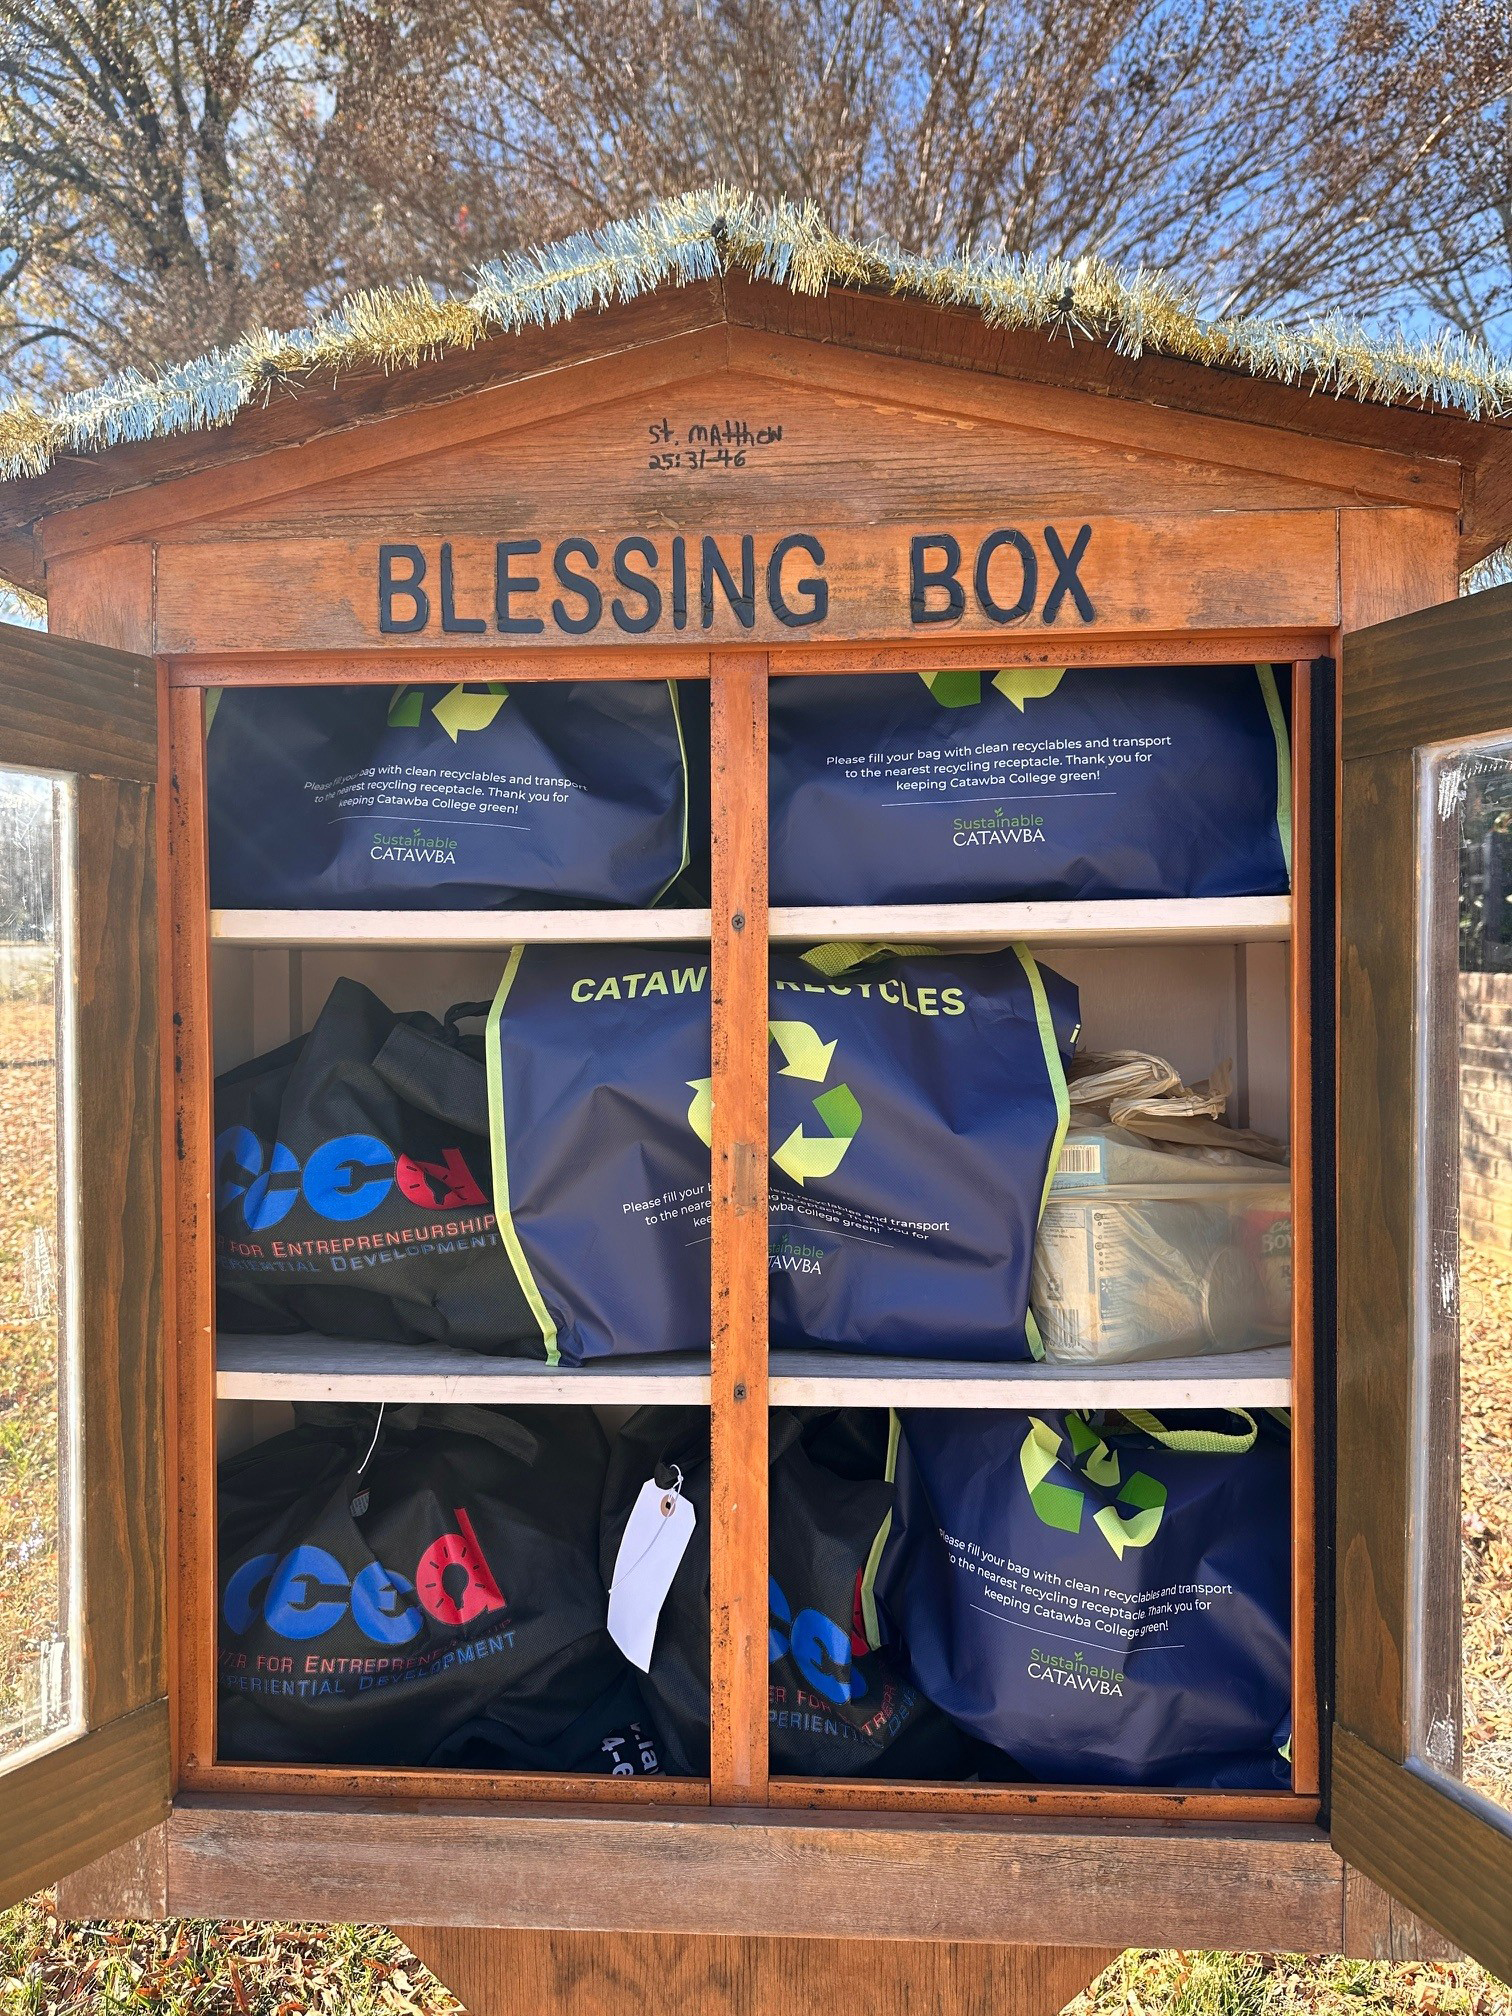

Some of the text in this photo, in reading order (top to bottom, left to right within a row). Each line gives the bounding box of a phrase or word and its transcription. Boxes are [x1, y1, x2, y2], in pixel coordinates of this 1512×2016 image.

[378, 524, 1095, 635] BLESSING BOX
[826, 736, 1172, 766] Please fill your bag with clean recyclables and transport
[845, 752, 1152, 778] to the nearest recycling receptacle. Thank you for
[304, 781, 332, 792] Please
[332, 776, 342, 786] fill
[378, 765, 402, 775] with
[405, 766, 436, 777] clean
[440, 769, 507, 783] recyclables
[509, 775, 532, 785] and
[535, 776, 588, 792] transport
[325, 790, 336, 801] the
[337, 781, 365, 796] nearest
[367, 780, 417, 793] recycling
[420, 783, 485, 796] receptacle.
[488, 787, 526, 800] Thank
[528, 793, 550, 803] you
[552, 792, 570, 803] for
[896, 770, 1101, 791] keeping Catawba College green!
[338, 794, 519, 814] keeping Catawba College green!
[953, 811, 1044, 831] Sustainable
[373, 830, 458, 849] Sustainable
[953, 828, 1046, 847] CATAWBA
[370, 846, 456, 864] CATAWBA
[571, 966, 708, 1003] CATAW
[622, 1198, 661, 1214] Please
[662, 1191, 677, 1203] fill
[679, 1185, 704, 1201] your
[645, 1200, 712, 1225] to the neare
[769, 1186, 795, 1197] lean
[865, 1213, 887, 1224] and
[890, 1218, 950, 1232] transport
[797, 1205, 840, 1223] College
[842, 1219, 881, 1234] green!
[887, 1226, 909, 1235] you
[912, 1231, 930, 1240] for
[768, 1254, 822, 1275] TAWBA
[939, 1528, 1233, 1604] Please fill your bag with clean recyclables and transport
[958, 1557, 976, 1572] the
[977, 1566, 1018, 1590] nearest
[1020, 1583, 1078, 1609] recycling
[1081, 1600, 1147, 1620] receptacle.
[1148, 1602, 1173, 1616] Thank
[1174, 1601, 1193, 1615] you
[1195, 1598, 1212, 1610] for
[984, 1585, 1169, 1640] keeping Catawba College green!
[257, 1654, 294, 1673] FOR
[1030, 1648, 1125, 1683] Sustainable
[1027, 1663, 1123, 1697] CATAWBA
